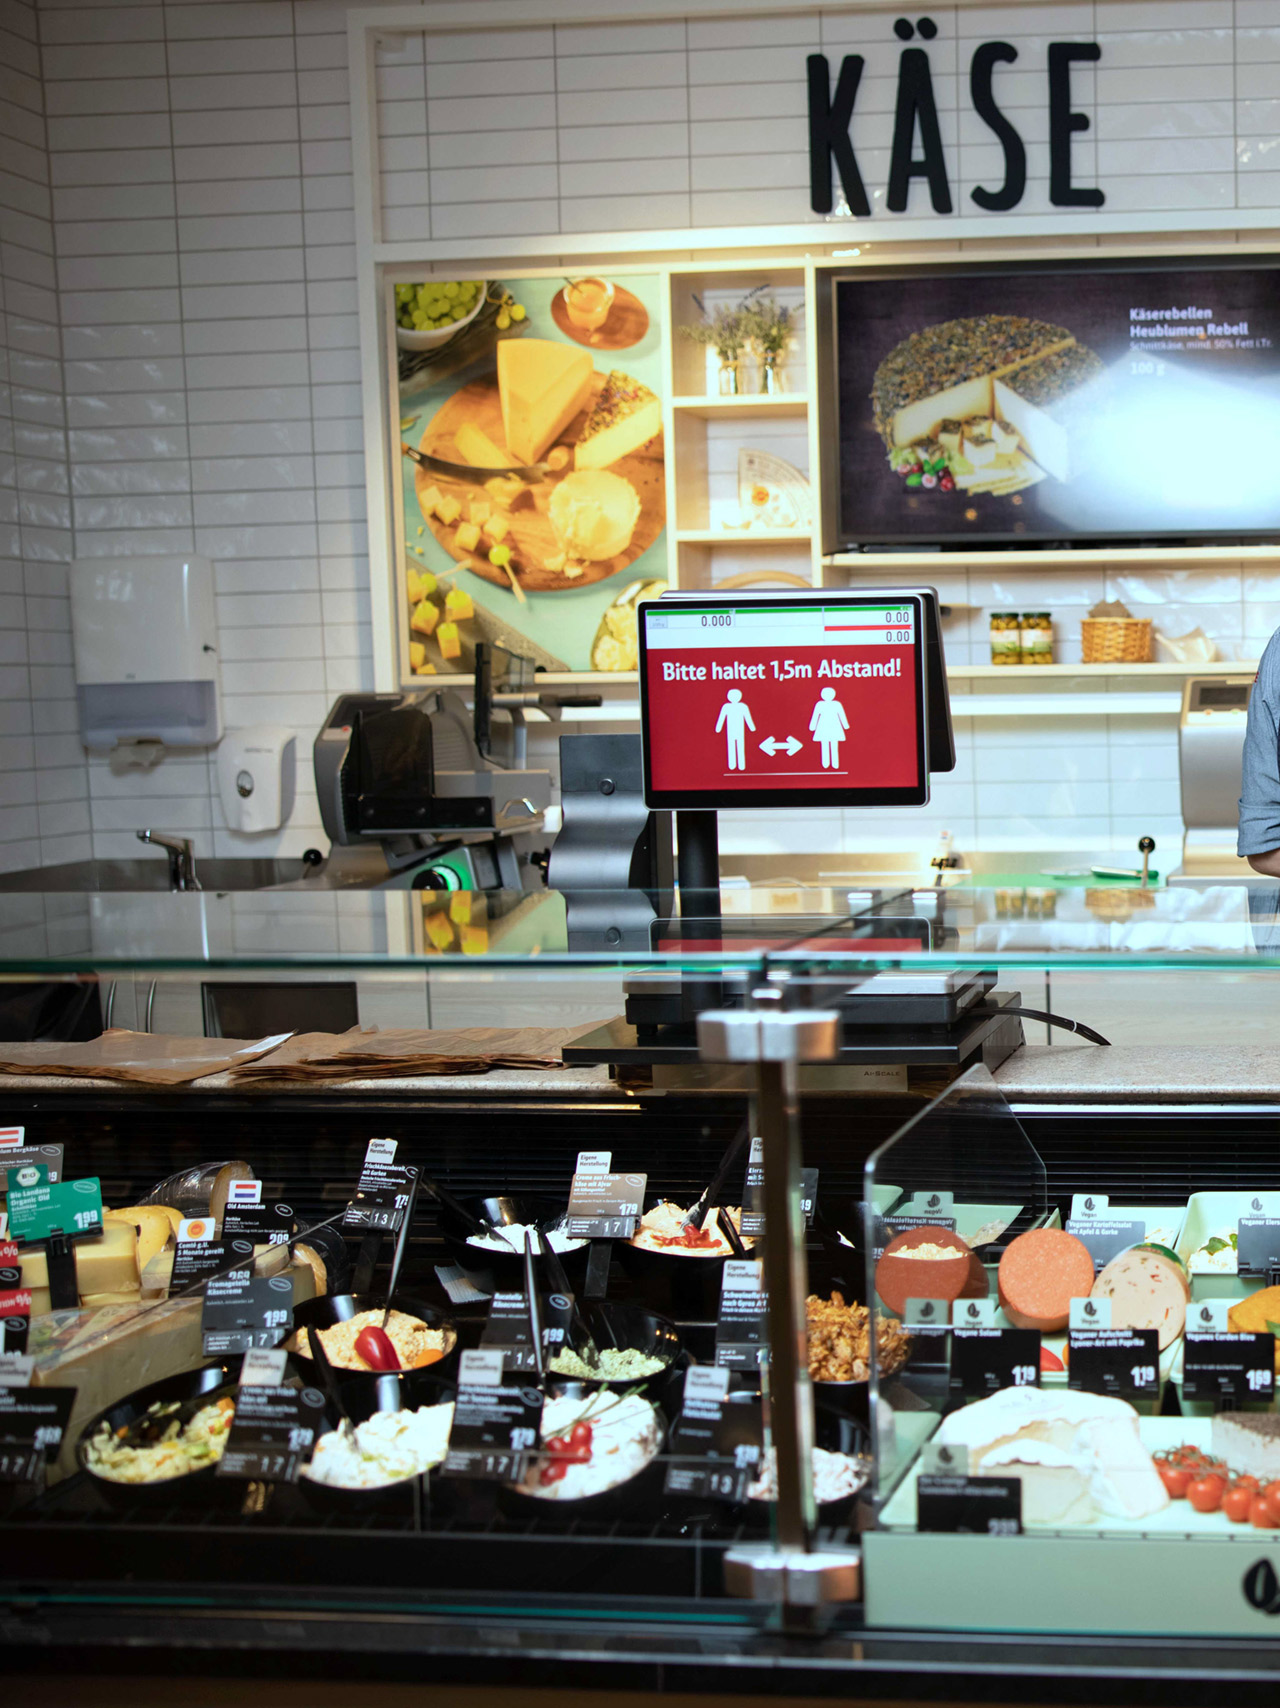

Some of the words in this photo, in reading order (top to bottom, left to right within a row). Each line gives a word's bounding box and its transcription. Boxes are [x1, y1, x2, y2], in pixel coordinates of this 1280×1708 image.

[806, 17, 1105, 216] KÄSE
[1129, 306, 1213, 321] Käserebellen
[1130, 323, 1205, 338] Heublumen
[1207, 321, 1249, 336] Rebell
[1130, 362, 1153, 375] 100
[701, 615, 731, 627] 0.000
[886, 612, 909, 623] 0.00
[886, 631, 909, 642] 0.00
[662, 661, 707, 681] Bitte
[712, 660, 765, 680] haltet
[770, 659, 812, 682] 1,5m
[817, 658, 902, 678] Abstand!
[38, 1193, 50, 1202] Old
[1068, 1221, 1092, 1229] Veganer
[1092, 1220, 1132, 1228] Kartoffelsalat
[1241, 1219, 1265, 1227] Veganer
[1079, 1228, 1094, 1236] Apfel
[727, 1272, 760, 1280] Herstellung
[953, 1329, 978, 1338] Vegane
[978, 1329, 1002, 1337] Salami
[1070, 1331, 1097, 1340] Veganer
[1098, 1330, 1133, 1338] Aufschnitt
[1214, 1333, 1239, 1342] Cordon
[1118, 1338, 1145, 1347] Paprika
